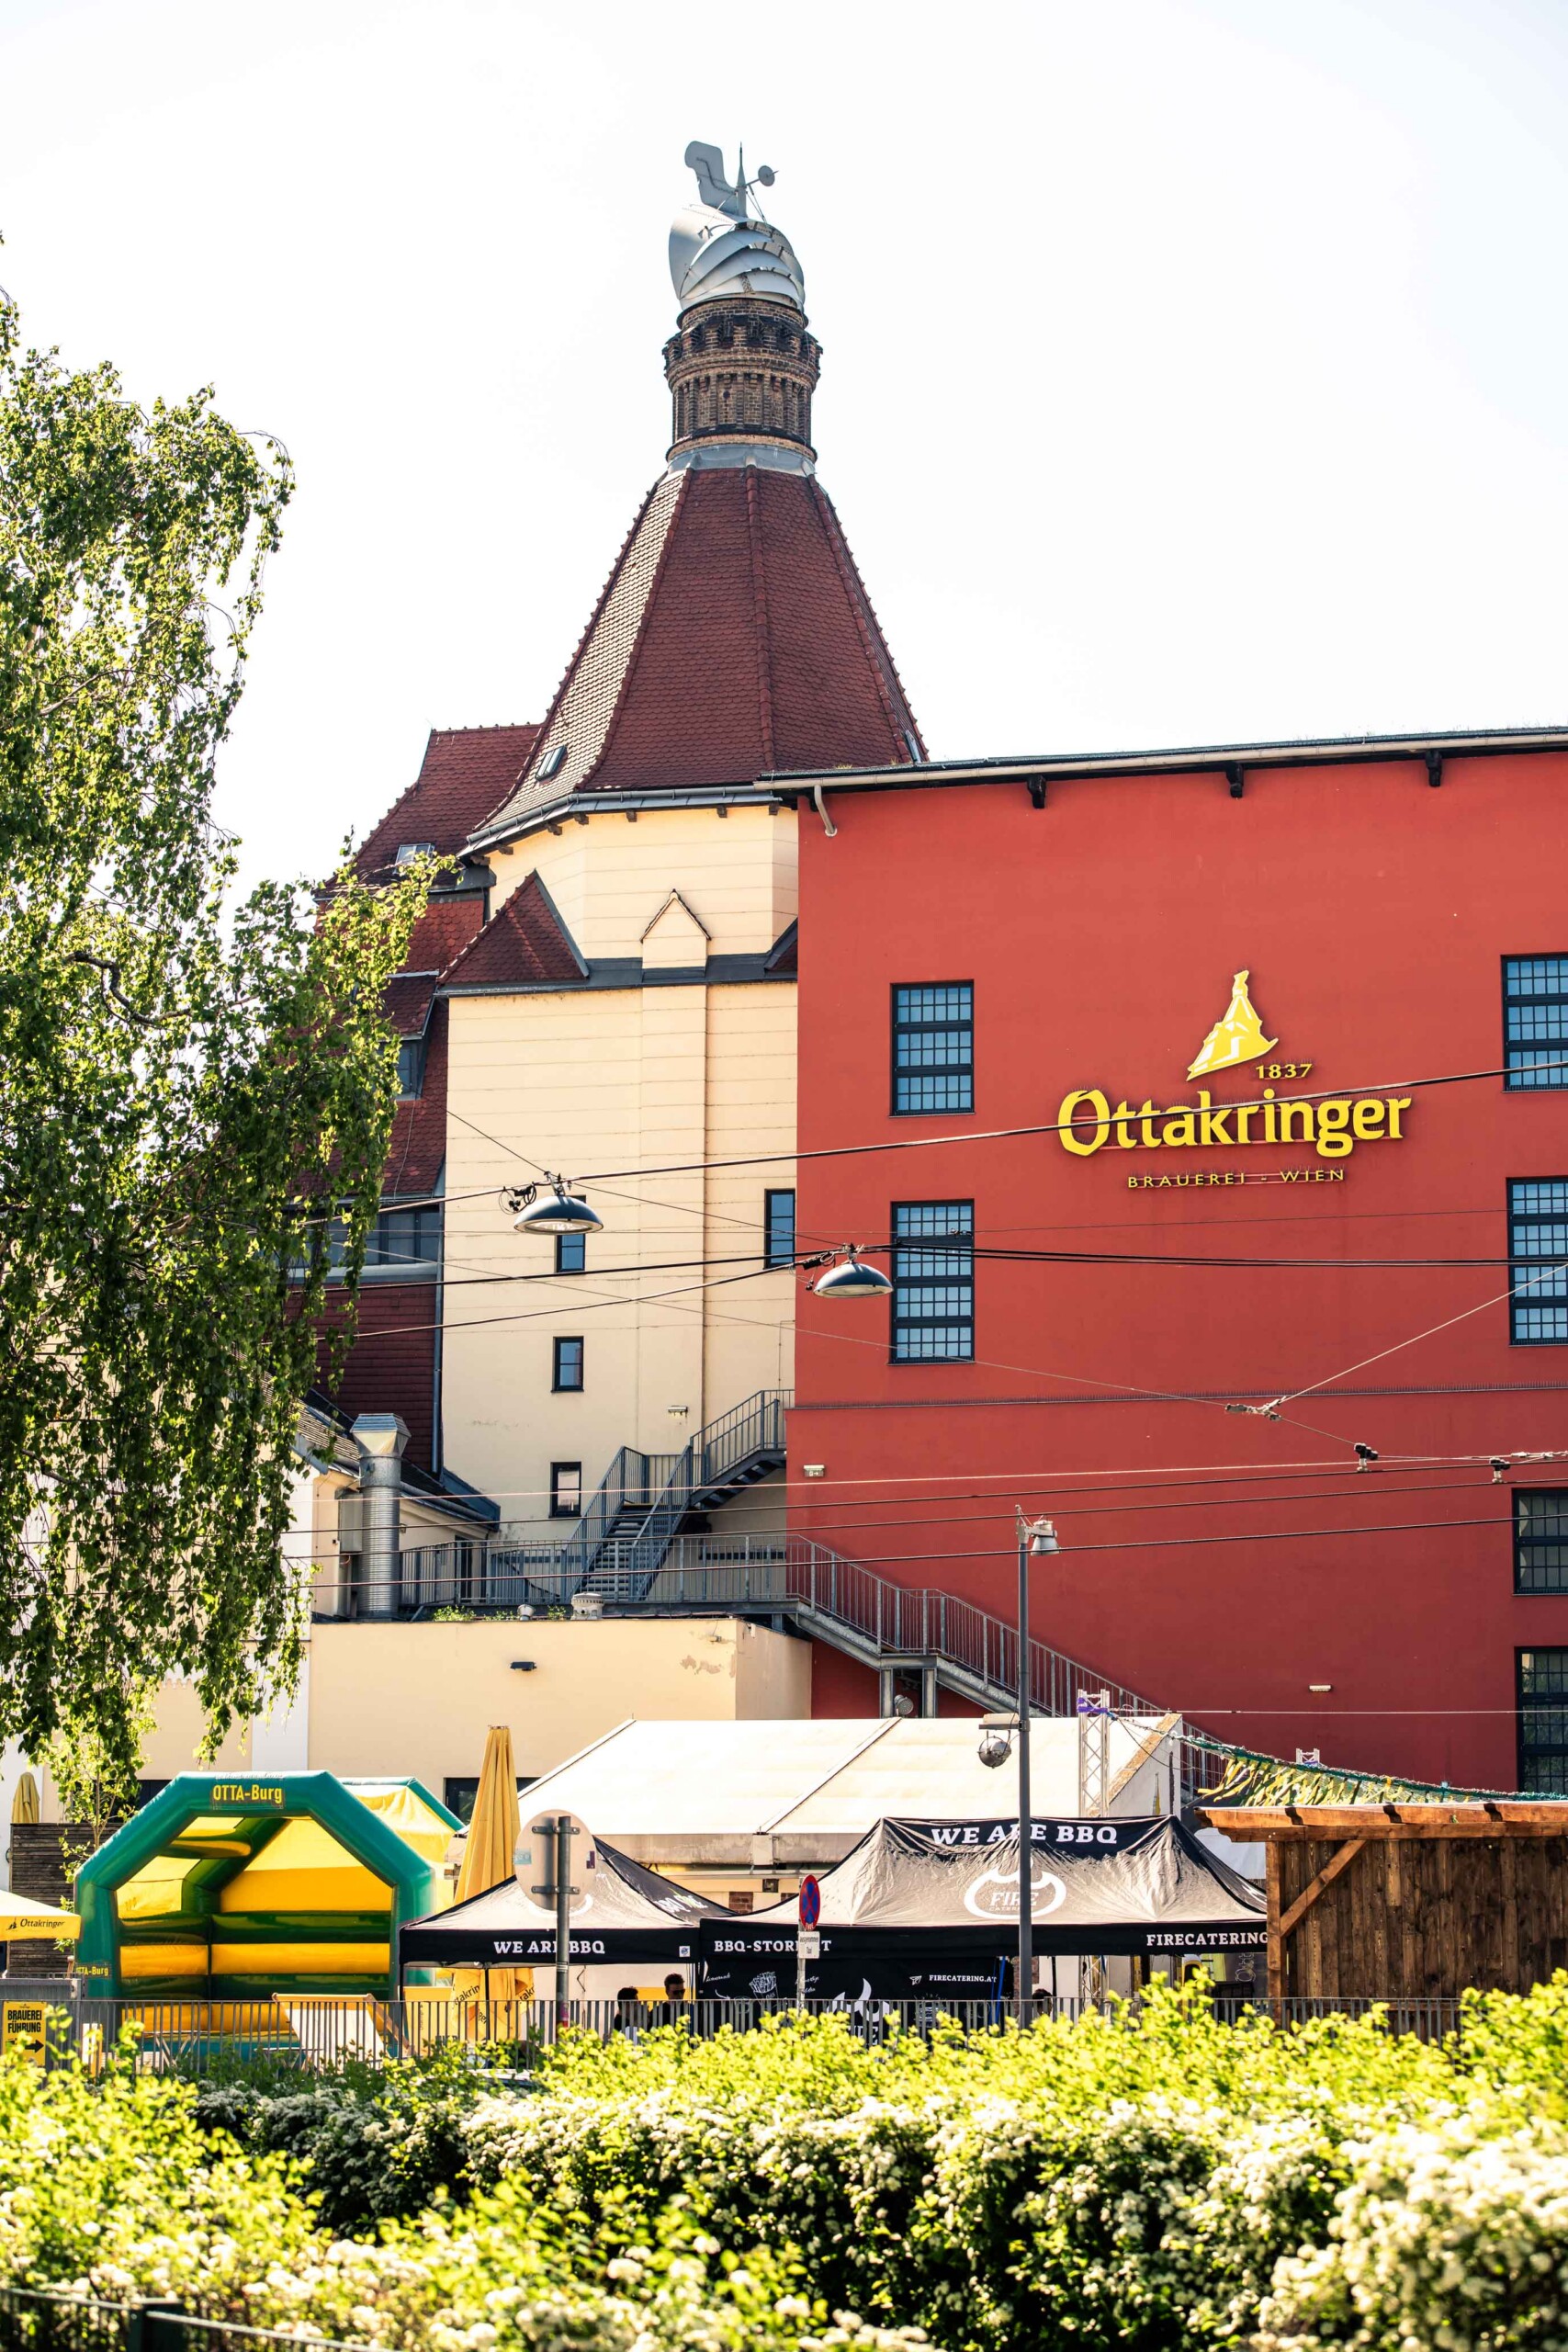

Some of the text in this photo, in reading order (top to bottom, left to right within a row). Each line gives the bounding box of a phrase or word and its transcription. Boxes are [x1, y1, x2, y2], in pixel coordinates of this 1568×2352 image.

[1255, 1063, 1313, 1080] 1837
[1057, 1088, 1413, 1158] Ottakringer
[1127, 1171, 1246, 1189] BRAUEREI
[1280, 1169, 1346, 1183] WIEN
[212, 1784, 283, 1804] OTTA-Burg
[931, 1826, 980, 1845] WE
[1055, 1826, 1118, 1844] BBQ
[19, 1918, 66, 1928] Ottakringer
[1146, 1932, 1268, 1946] FIRECATERING
[493, 1940, 524, 1954] WE
[569, 1940, 605, 1954] BBQ
[928, 1974, 997, 1983] FIRECATERING.AT
[7, 2009, 42, 2021] BRAUEREI
[7, 2020, 42, 2034] FÜHRUNG
